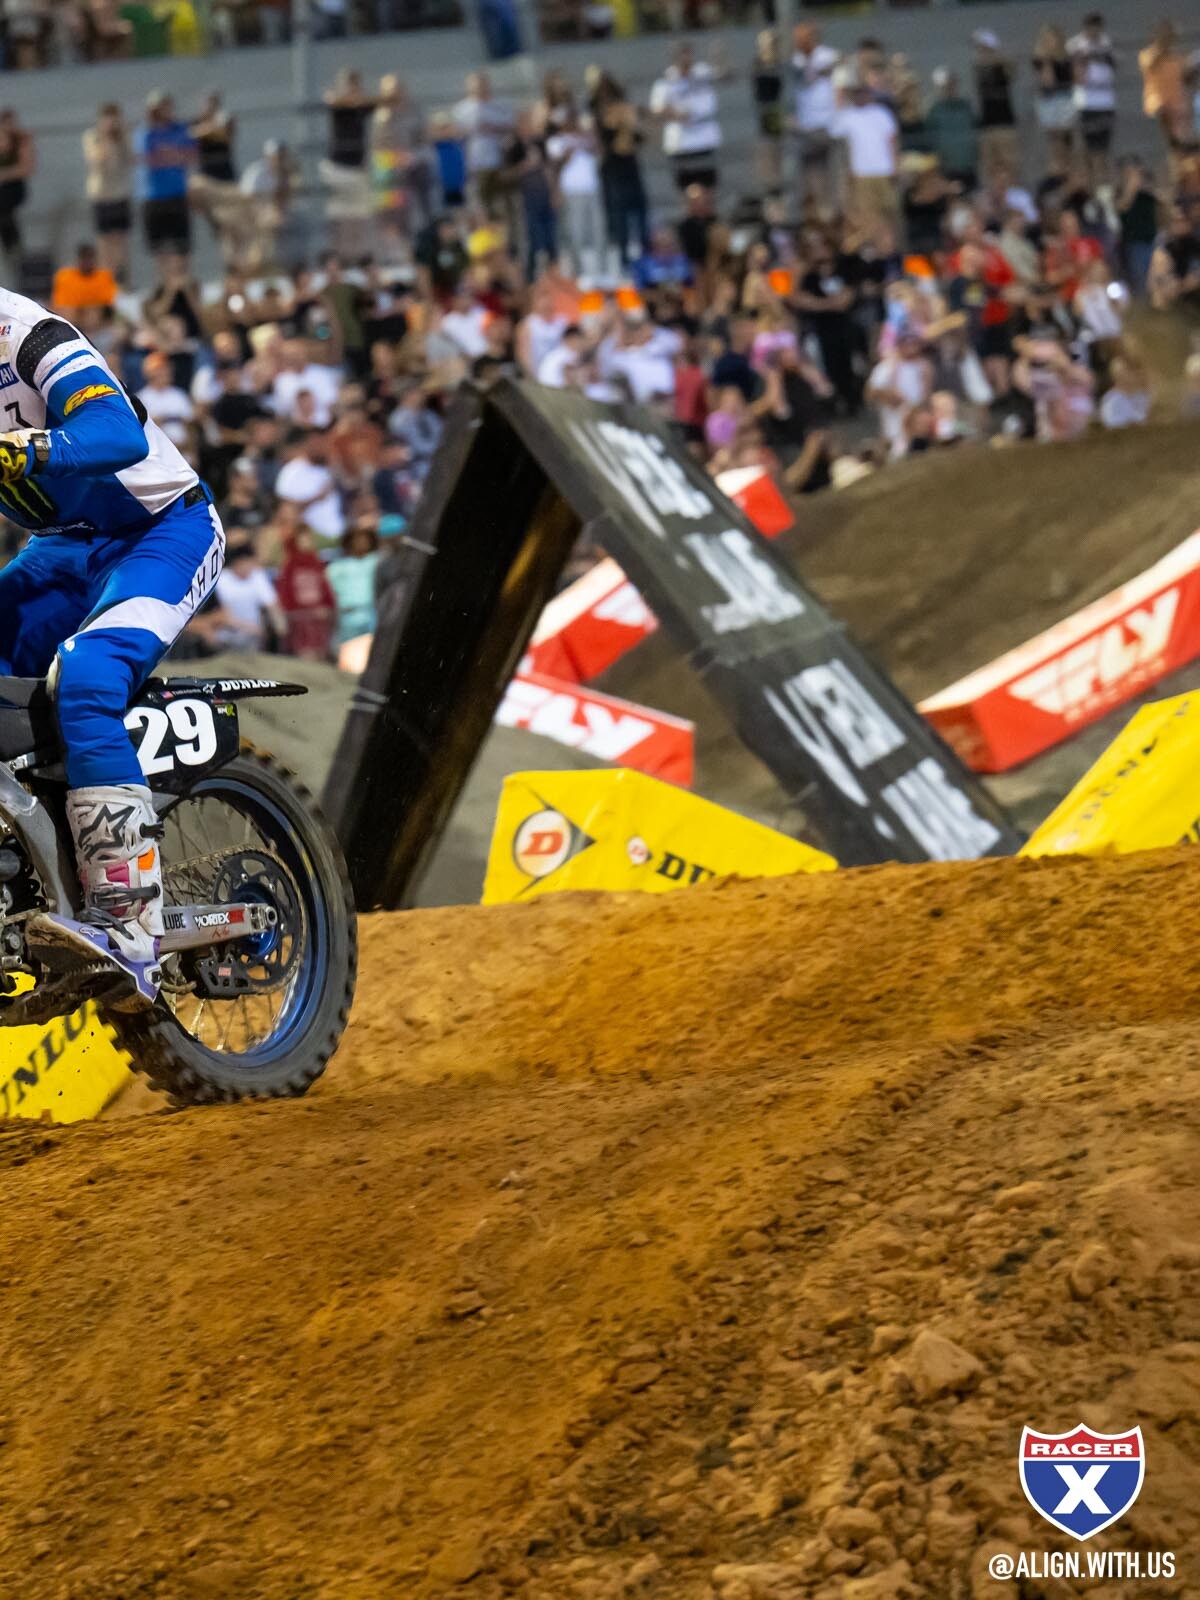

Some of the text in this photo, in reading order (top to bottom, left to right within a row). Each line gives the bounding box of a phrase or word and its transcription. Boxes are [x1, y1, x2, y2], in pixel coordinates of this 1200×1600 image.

[218, 680, 282, 693] DUNLOP
[123, 699, 217, 776] 29
[163, 914, 186, 930] LUBE
[195, 912, 230, 927] VORTEX
